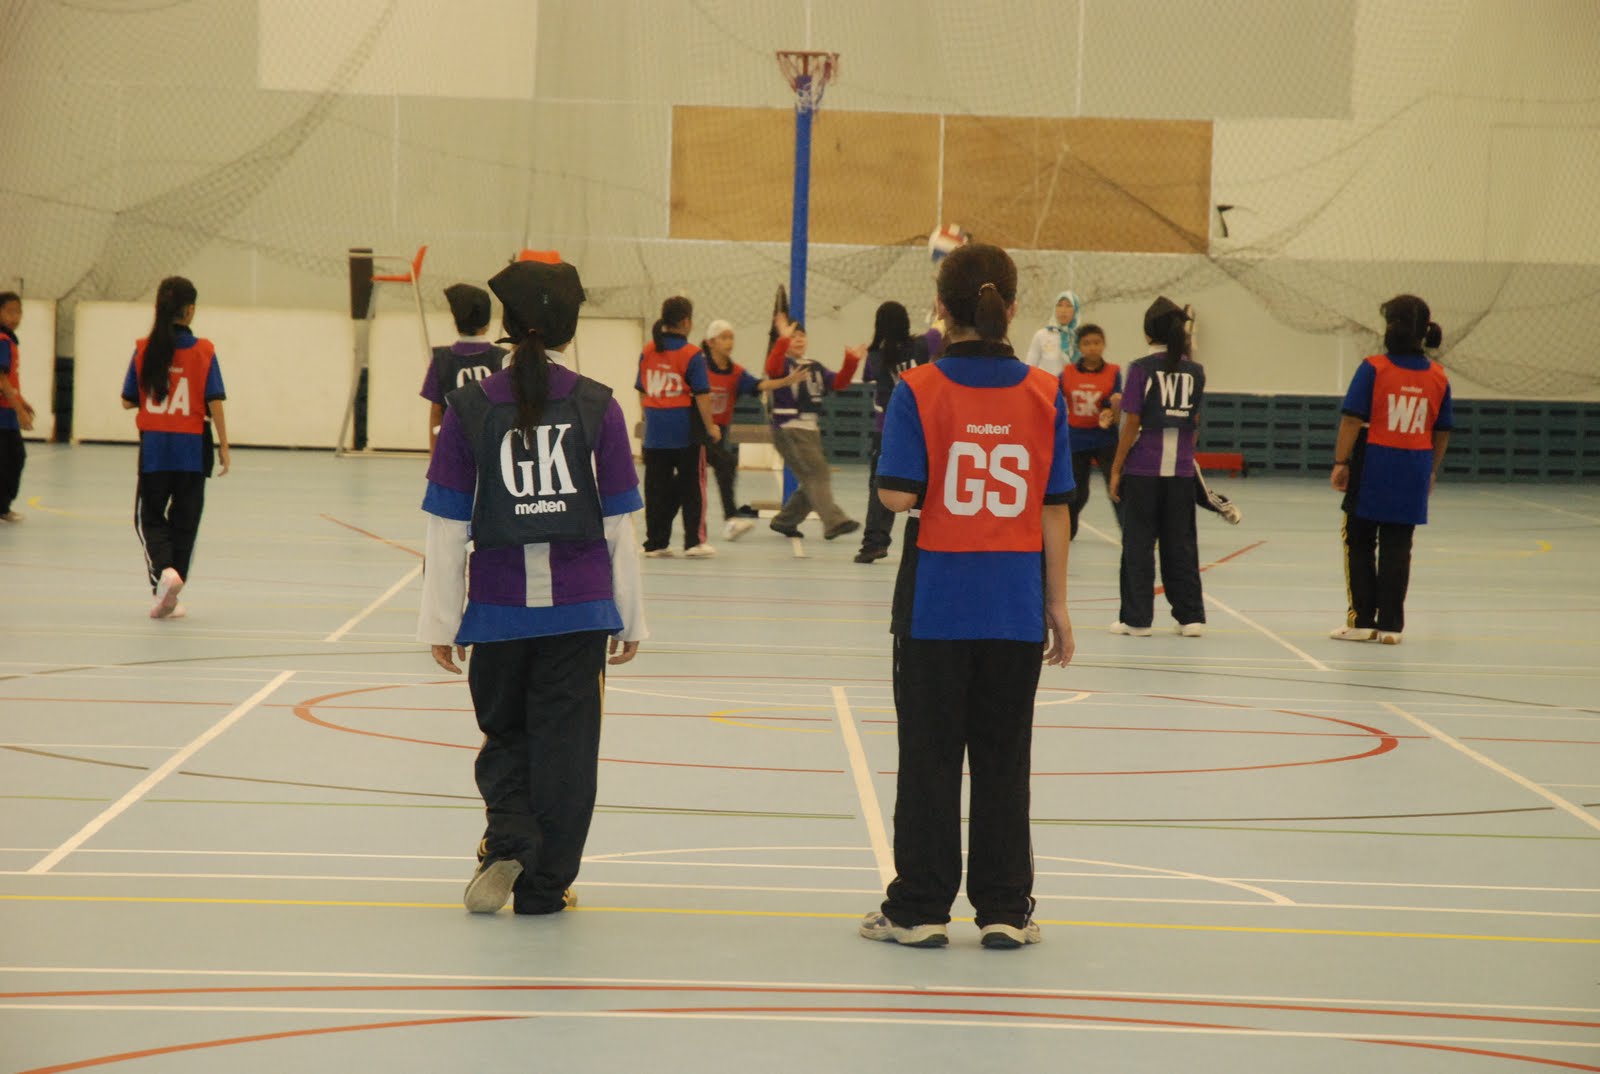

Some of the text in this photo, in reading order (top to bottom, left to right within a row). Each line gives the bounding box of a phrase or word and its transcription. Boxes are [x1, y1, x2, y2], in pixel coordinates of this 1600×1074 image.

[966, 423, 1011, 434] molten
[1387, 393, 1428, 434] WA
[501, 423, 577, 497] GK
[943, 441, 1030, 518] GS
[514, 500, 567, 515] molten
